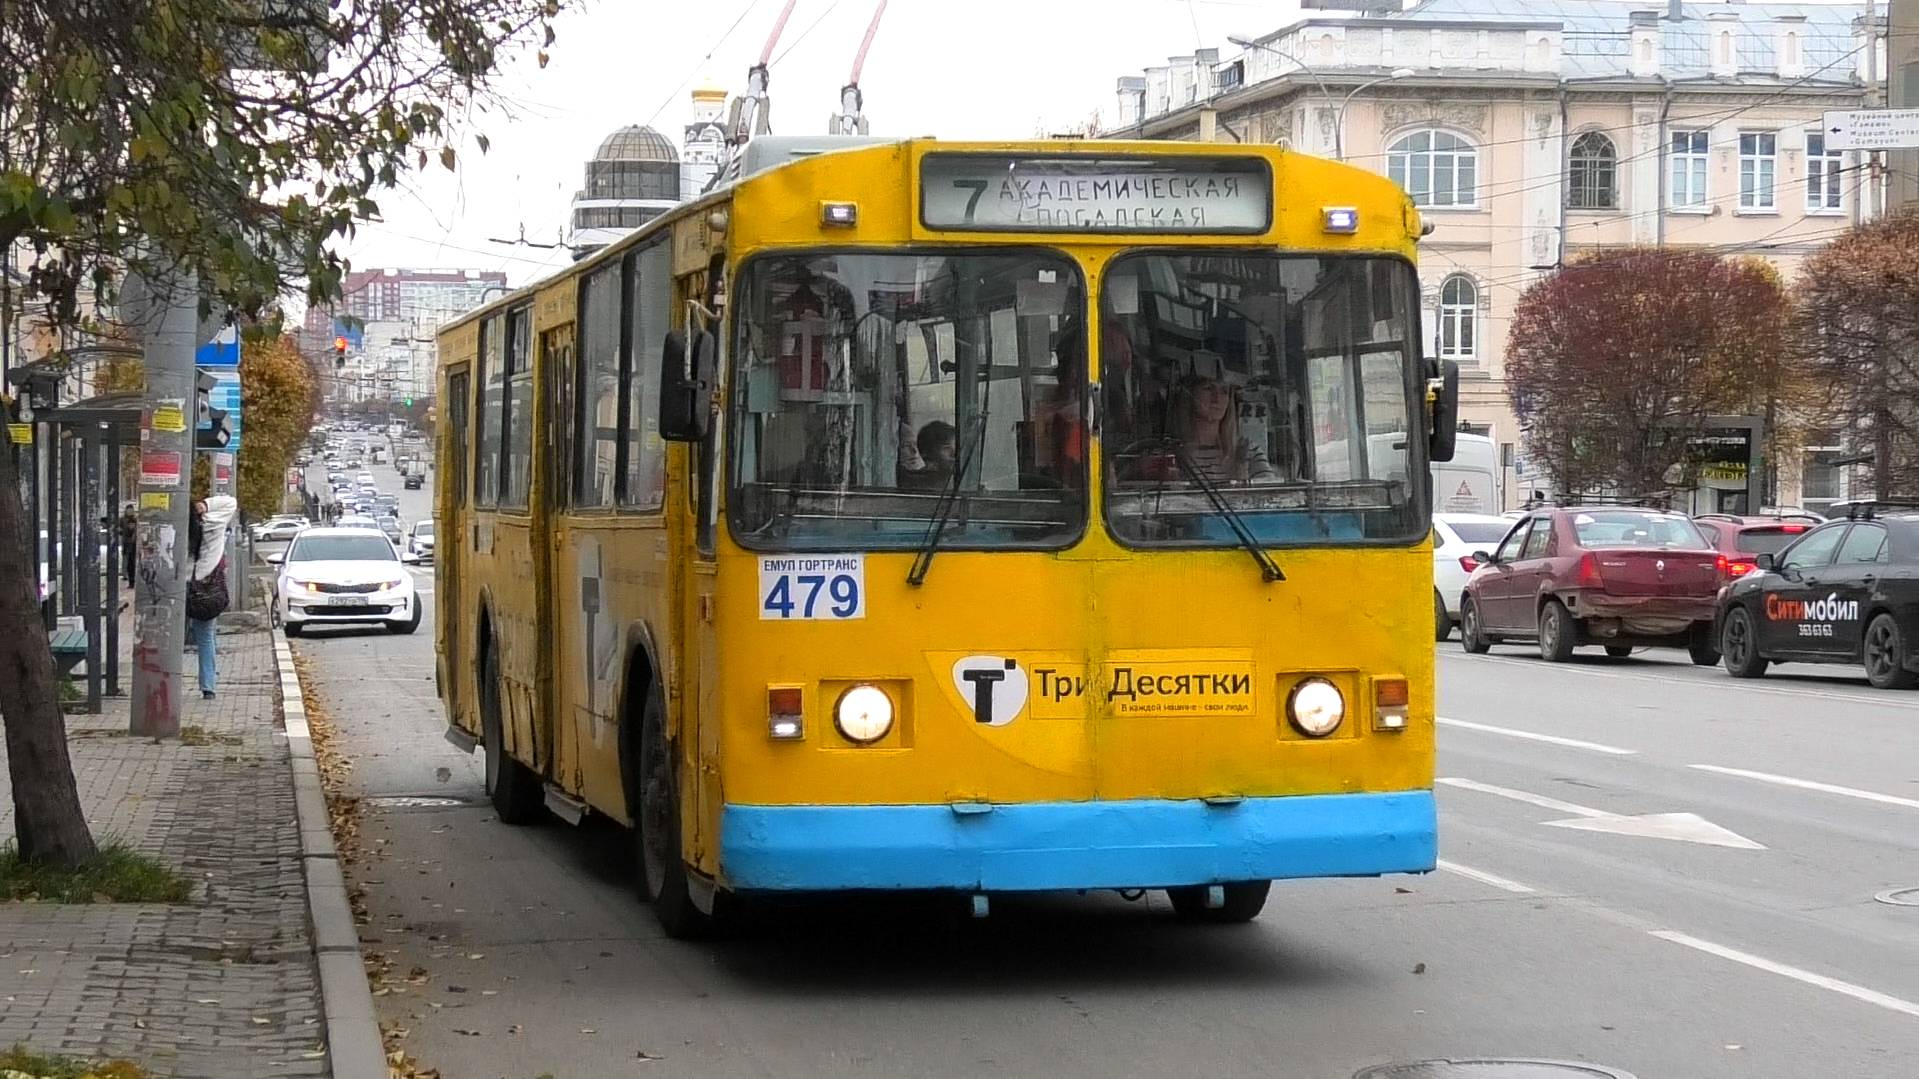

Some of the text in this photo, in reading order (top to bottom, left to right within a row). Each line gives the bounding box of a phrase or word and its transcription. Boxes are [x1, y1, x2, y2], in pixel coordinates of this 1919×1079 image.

[953, 179, 989, 223] 7
[999, 177, 1240, 202] АКАДЕМИЧЕСКАЯ
[764, 558, 858, 571] ЕМУП ГОРТРАНС
[764, 574, 859, 619] 479
[1767, 591, 1859, 621] Ситимобил
[1034, 667, 1251, 703] Три Десятки
